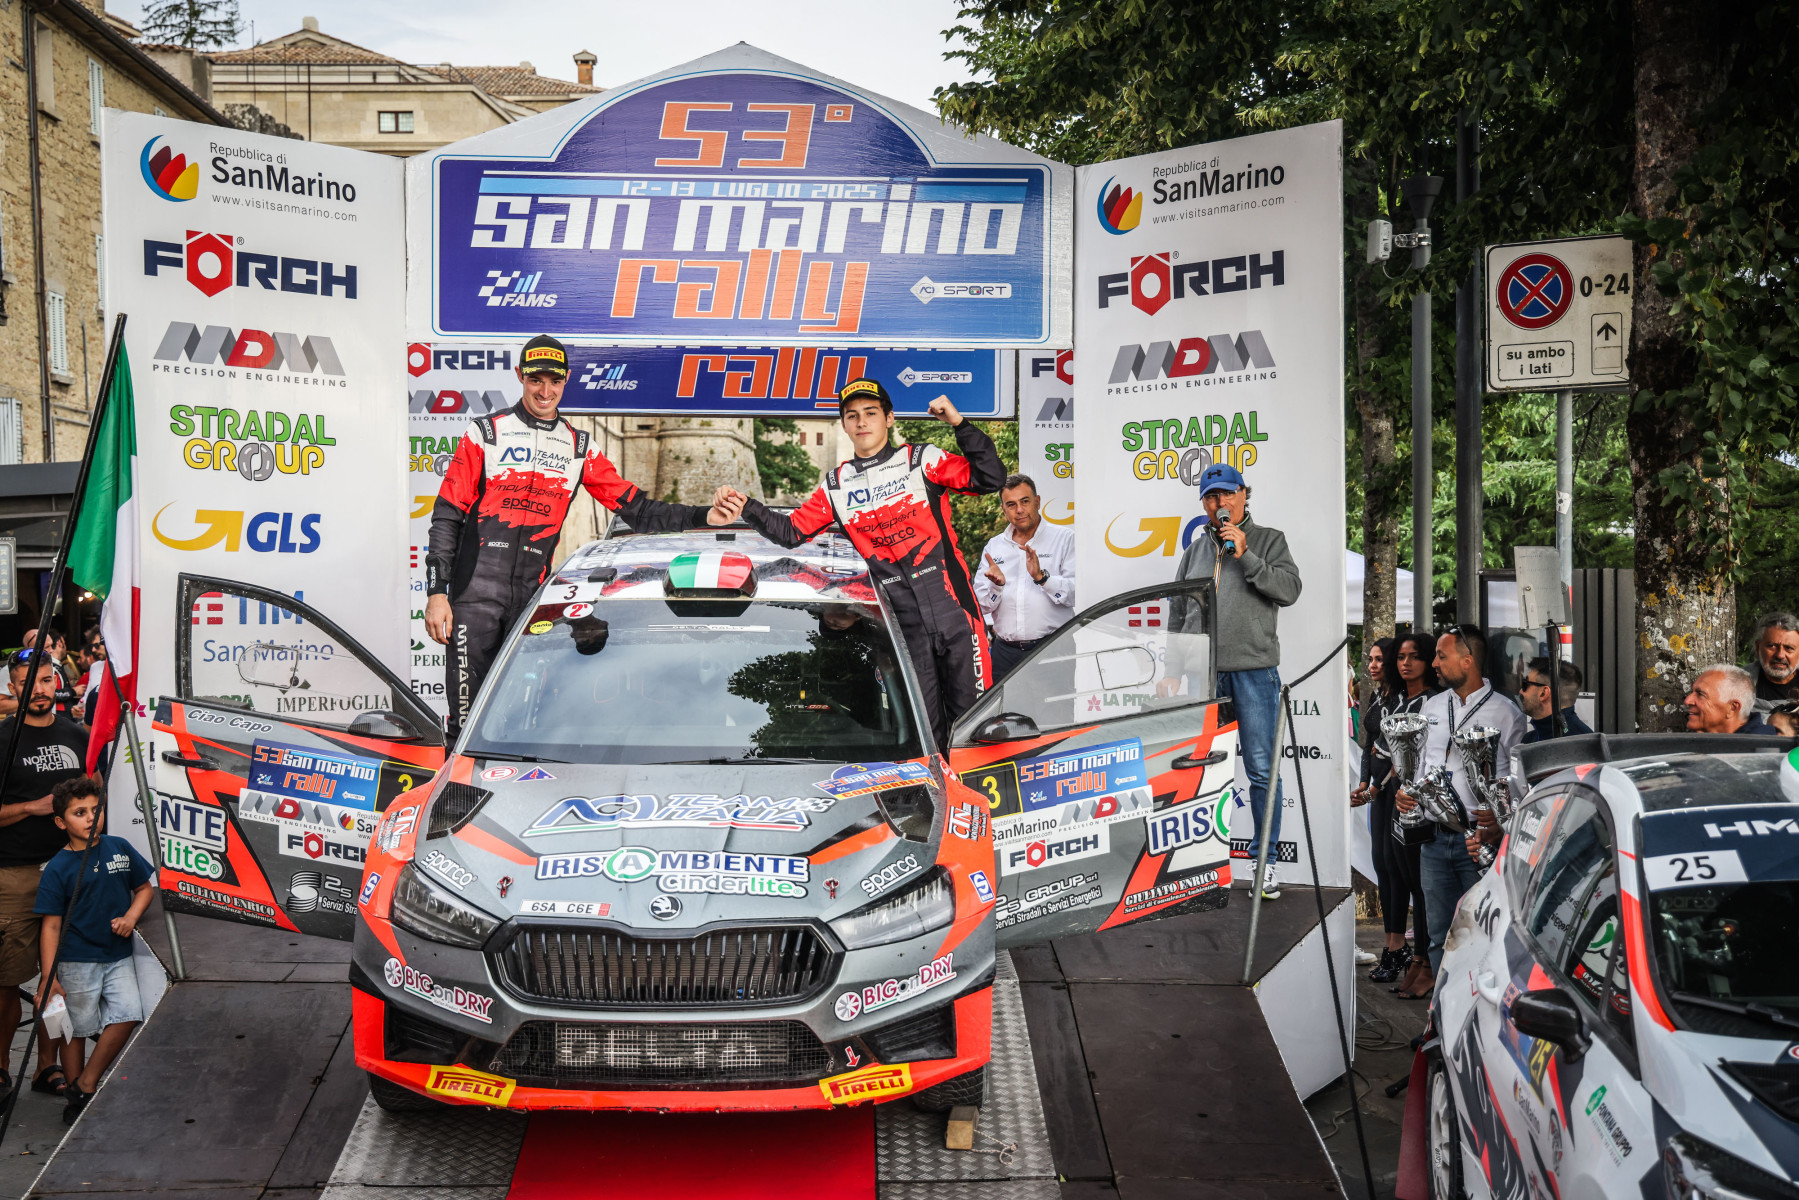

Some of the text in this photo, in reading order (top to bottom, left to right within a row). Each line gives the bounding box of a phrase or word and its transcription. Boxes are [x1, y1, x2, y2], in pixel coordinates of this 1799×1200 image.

[209, 142, 287, 165] Repubblica di
[211, 156, 356, 202] SanMarino
[1152, 156, 1220, 178] Repubblica di
[712, 182, 801, 198] LUGLIO
[811, 183, 877, 199] 2025
[1153, 164, 1284, 205] SanMarino
[211, 194, 357, 222] www.visitsanmarino.com
[470, 184, 1024, 255] san marino
[1152, 195, 1285, 225] www.visitsanmarino.com
[610, 248, 870, 333] rally
[943, 285, 1007, 296] SPORT
[1579, 273, 1630, 297] 0-24
[501, 293, 558, 308] FAMS
[153, 320, 346, 376] MDM
[1107, 330, 1276, 384] MDM
[1507, 347, 1565, 360] su ambo
[153, 365, 347, 388] PRECISION ENGINEERING
[921, 373, 968, 381] SPORT
[1520, 363, 1552, 375] i lati
[595, 379, 638, 390] FAMS
[1107, 371, 1277, 396] PRECISION ENGINEERING
[170, 405, 336, 446] STRADAL
[1122, 410, 1268, 451] STRADAL
[183, 438, 325, 482] GROUP
[500, 446, 531, 463] ACI
[531, 457, 566, 471] ITALIA
[537, 450, 565, 462] TEAM
[847, 488, 871, 507] ACI
[871, 483, 906, 503] ITALIA
[873, 480, 901, 494] TEAM
[502, 497, 552, 514] sparco
[246, 512, 321, 554] GLS
[871, 527, 915, 547] sparco
[563, 585, 578, 600] 3
[203, 639, 334, 663] San Marino
[276, 693, 390, 713] IMPERFOGLIA
[187, 709, 273, 733] Ciao Capo
[23, 753, 61, 766] NORTH
[37, 744, 59, 755] THE
[1049, 760, 1079, 777] san
[1082, 747, 1139, 770] marino
[36, 761, 64, 773] FACE
[282, 752, 312, 770] san
[315, 757, 376, 781] marino
[283, 772, 337, 799] rally
[982, 775, 1001, 809] 3
[1056, 771, 1107, 797] rally
[241, 792, 336, 828] MDM
[668, 794, 798, 808] TEAM
[1058, 788, 1152, 827] MDM
[240, 812, 337, 834] PRECISION ENGINEERING
[654, 806, 809, 825] ITALIA
[1058, 808, 1154, 833] PRECISION ENGINEERING
[1151, 806, 1211, 851] IRIS
[424, 850, 474, 888] sparco
[540, 856, 600, 877] IRIS
[861, 853, 920, 897] sparco
[1669, 856, 1717, 882] 25
[178, 881, 275, 917] GIULIATO ENRICO
[1026, 875, 1085, 902] GROUP
[1125, 871, 1219, 906] GIULIATO ENRICO
[322, 897, 344, 911] Servizi
[1017, 906, 1041, 922] Stradali
[1048, 897, 1069, 913] Servizi
[1069, 887, 1101, 904] Energetici
[561, 1028, 761, 1068] DELTA
[432, 1070, 507, 1099] PIRELLI
[828, 1069, 905, 1099] PIRELLI
[1597, 1102, 1613, 1133] FONTANA
[1611, 1127, 1633, 1157] GRUPPO
